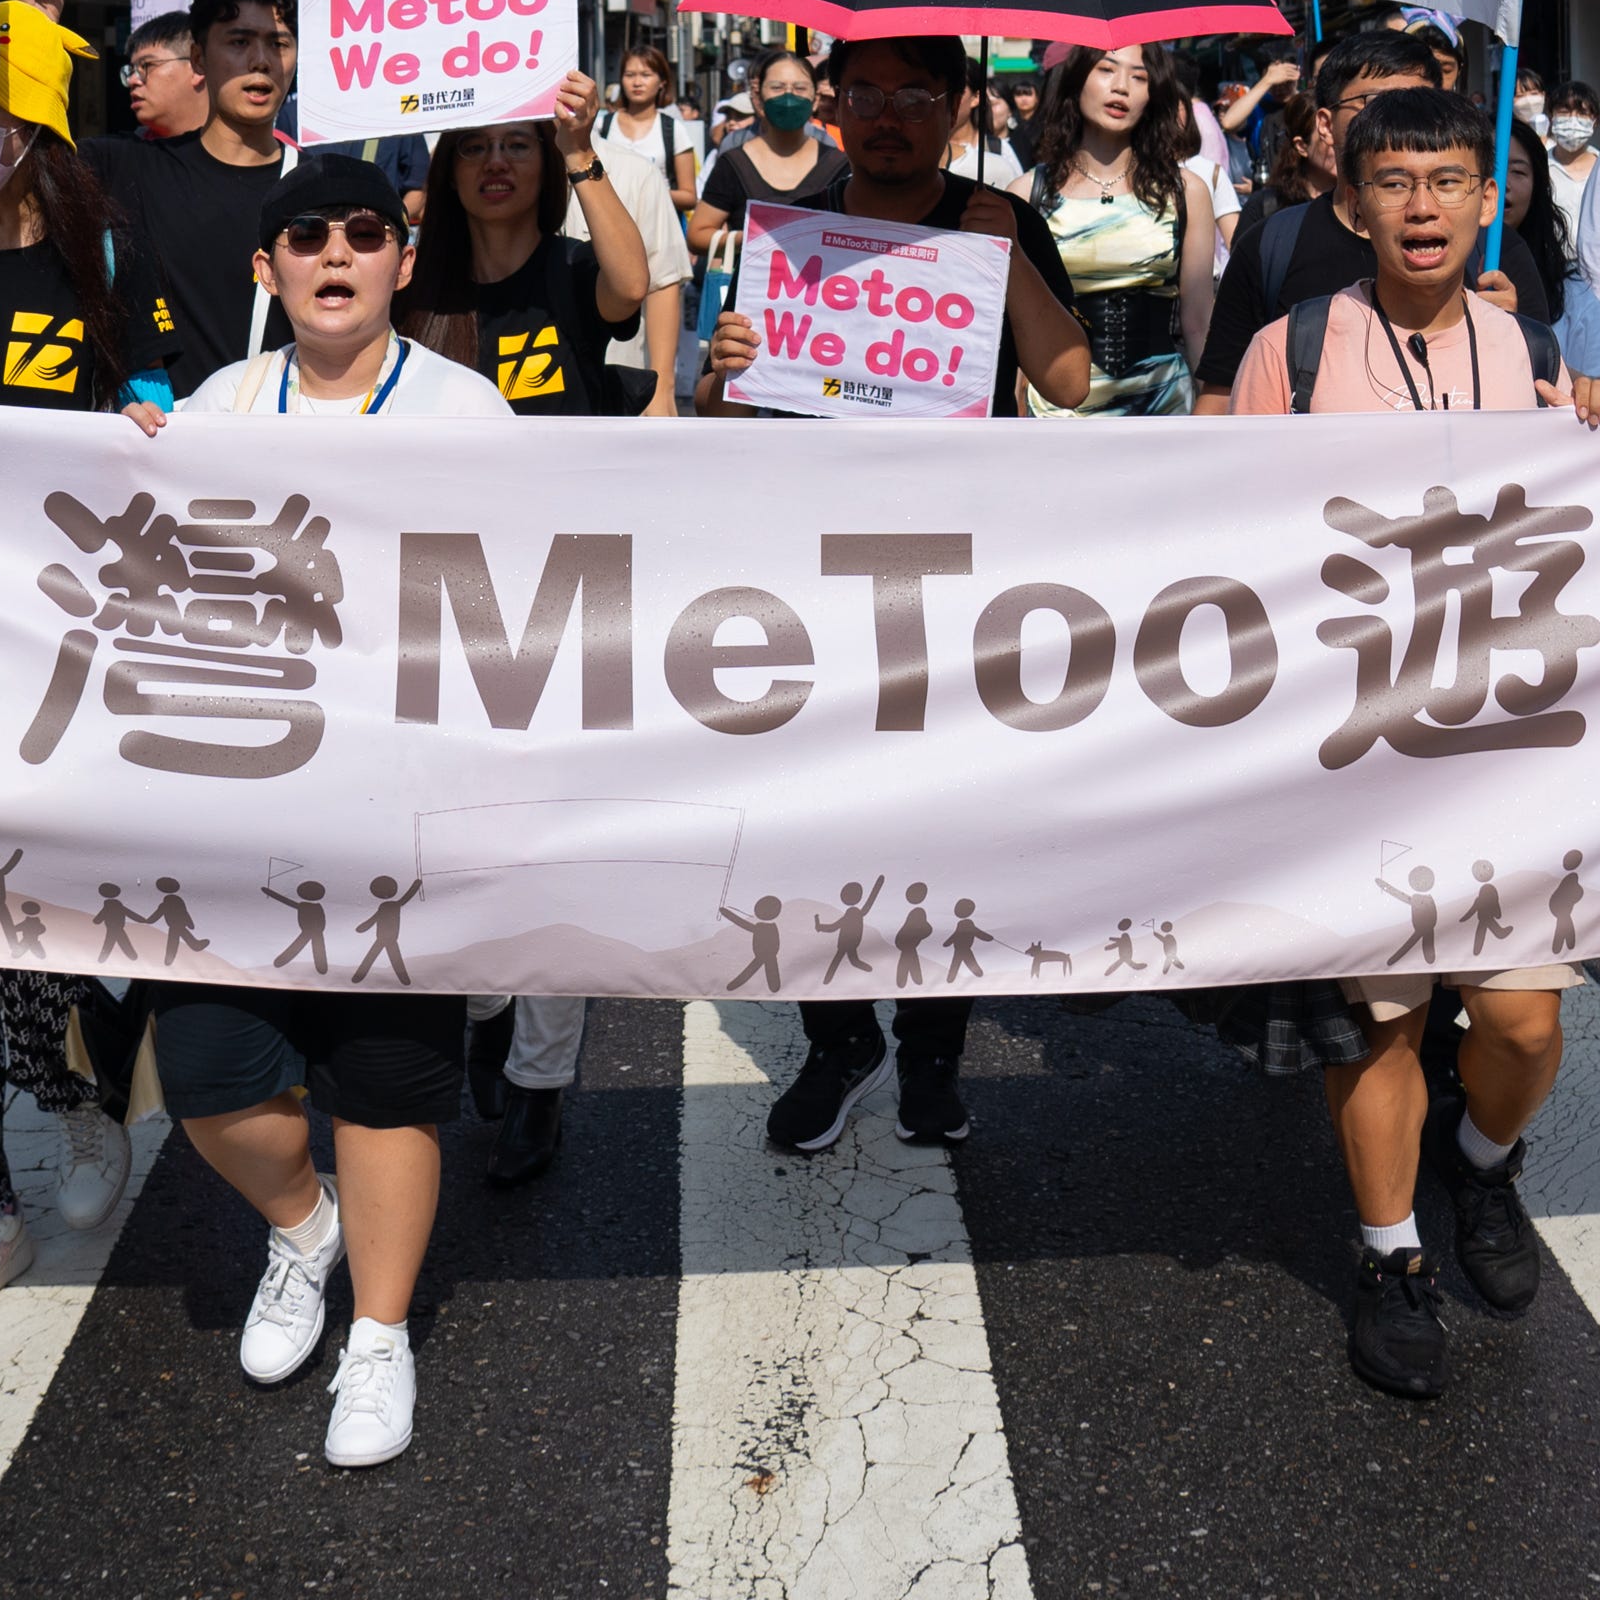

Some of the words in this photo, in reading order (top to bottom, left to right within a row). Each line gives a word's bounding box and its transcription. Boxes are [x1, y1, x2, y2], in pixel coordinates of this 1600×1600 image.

[329, 41, 421, 92] We
[441, 29, 544, 79] do!
[422, 88, 475, 106] 時代力量
[422, 104, 437, 112] NEW
[438, 102, 456, 111] POWER
[456, 101, 475, 109] PARTY
[767, 249, 975, 330] Metoo
[764, 308, 846, 366] We
[865, 329, 964, 387] do!
[843, 380, 894, 401] 時代力量
[843, 394, 858, 402] NEW
[859, 396, 875, 405] POWER
[875, 399, 892, 408] PARTY
